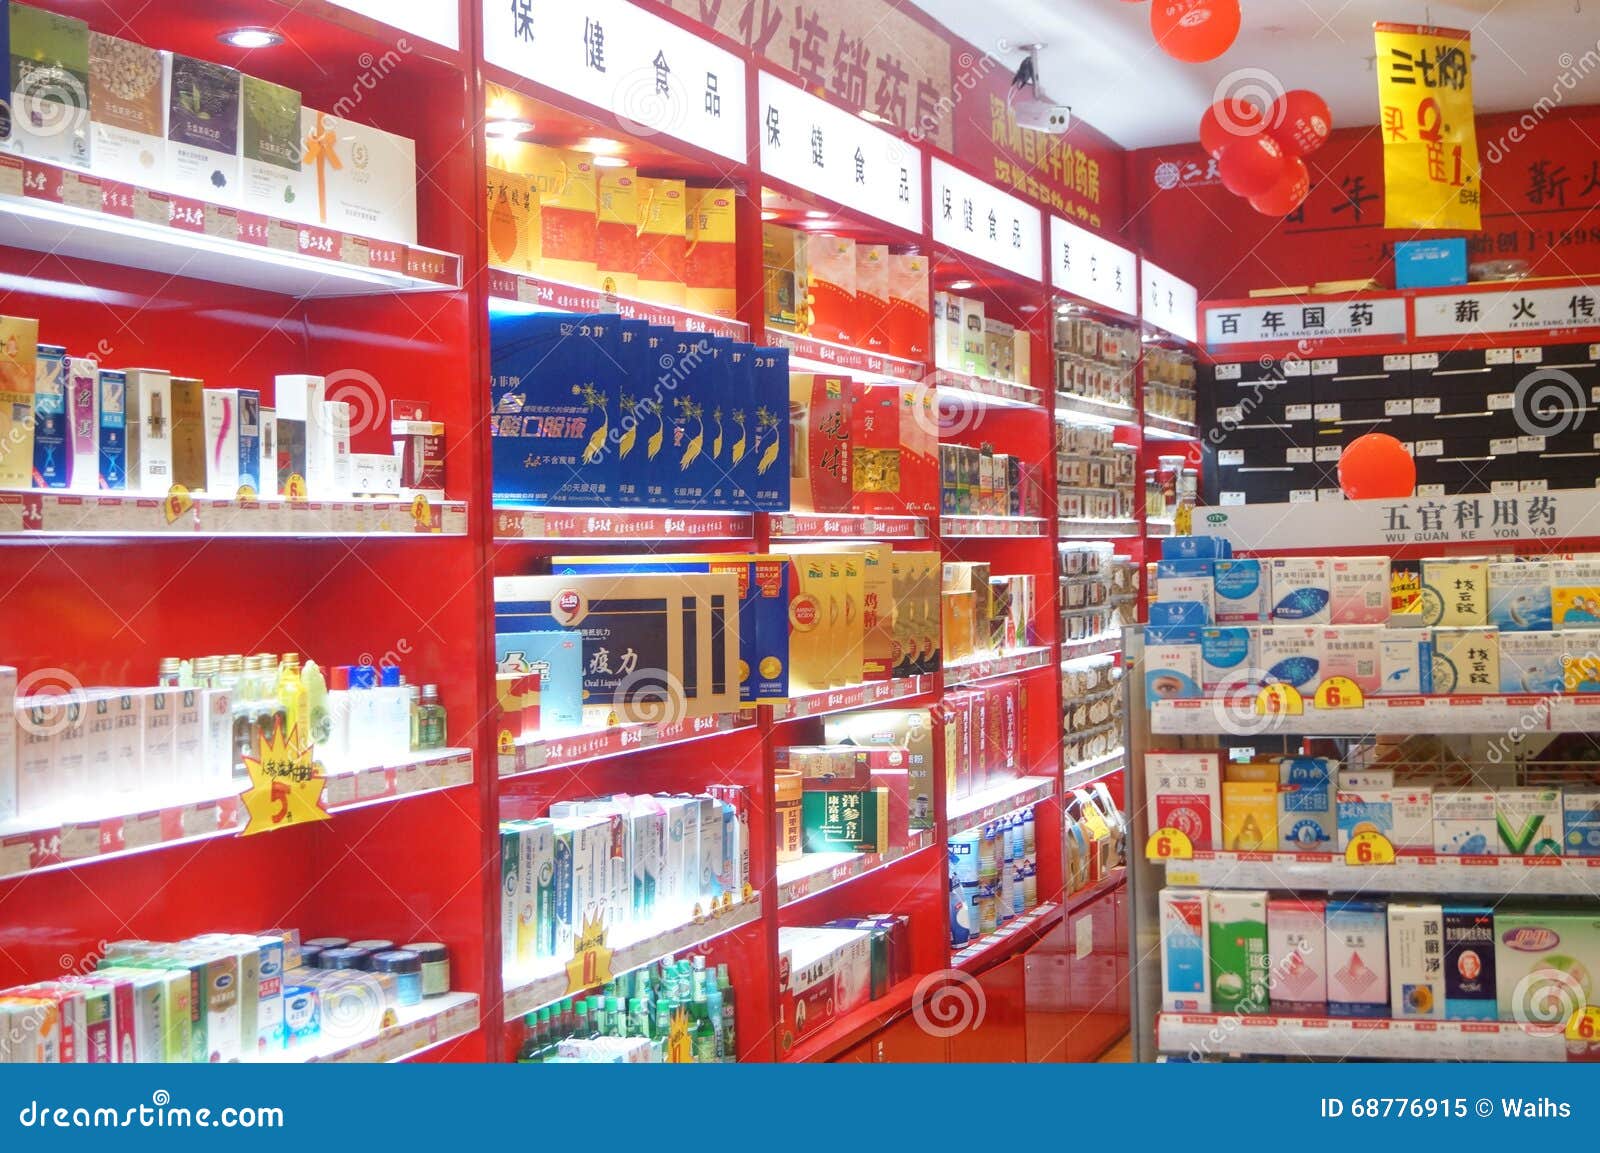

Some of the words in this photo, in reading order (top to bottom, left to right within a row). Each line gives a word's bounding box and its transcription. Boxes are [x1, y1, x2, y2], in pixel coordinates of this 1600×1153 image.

[511, 0, 721, 118] 保健食品
[1391, 45, 1467, 90] 三七粉
[766, 104, 909, 202] 保健食品
[1450, 145, 1464, 186] 1
[1217, 303, 1373, 334] 百年国药
[1455, 296, 1595, 323] 薪火传
[1381, 496, 1557, 532] 五官科用药
[1385, 533, 1406, 543] WU
[1414, 532, 1449, 542] GUAN
[1460, 531, 1476, 540] KE
[1493, 528, 1520, 539] YON
[1531, 526, 1557, 537] YAO
[583, 647, 638, 676] 疫力
[584, 679, 599, 688] Oral
[271, 781, 291, 824] 5
